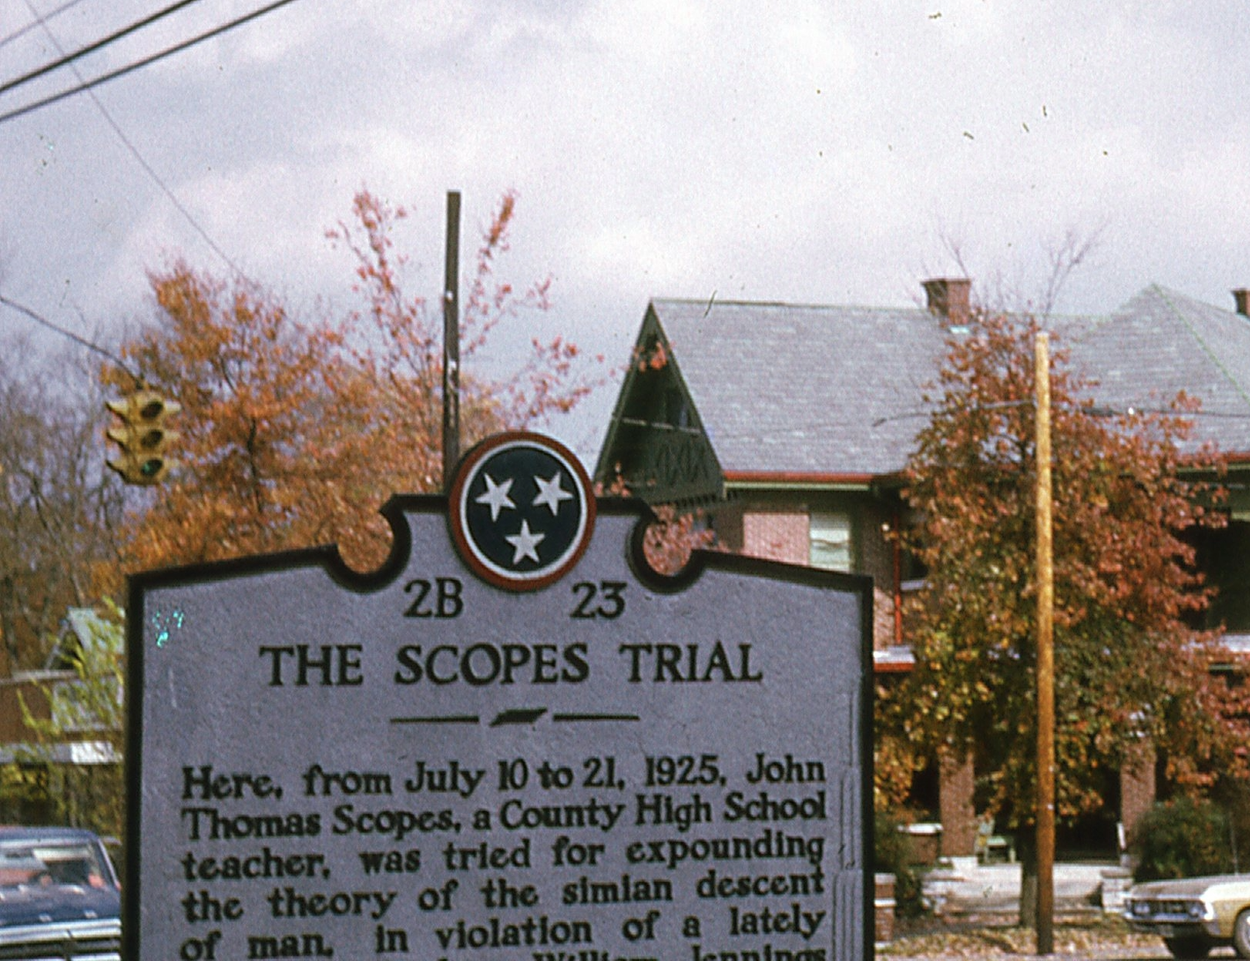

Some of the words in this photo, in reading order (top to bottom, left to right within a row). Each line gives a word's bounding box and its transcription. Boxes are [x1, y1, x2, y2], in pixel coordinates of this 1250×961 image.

[403, 577, 464, 619] 2B
[569, 580, 627, 620] 23
[258, 643, 364, 687] THE
[394, 642, 590, 687] SCOPES
[618, 640, 763, 684] TRIAL
[181, 765, 284, 801] Here,
[302, 763, 393, 796] from
[404, 760, 486, 799] July
[497, 757, 529, 791] 10
[536, 761, 574, 790] to
[582, 756, 625, 791] 21,
[645, 754, 727, 787] 1925,
[745, 752, 827, 783] John
[180, 805, 322, 841] Thomas
[331, 803, 462, 842] Scopes,
[472, 809, 492, 831] a
[499, 796, 627, 833] County
[635, 793, 713, 832] High
[722, 790, 827, 822] School
[180, 847, 332, 883] teacher,
[358, 849, 422, 875] was
[442, 839, 532, 872] tried
[551, 835, 605, 867] for
[625, 828, 826, 870] expounding
[181, 890, 245, 924] the
[266, 885, 398, 922] theory
[417, 879, 460, 912] of
[479, 877, 539, 910] the
[561, 875, 674, 906] simian
[696, 868, 826, 900] descent
[179, 930, 223, 961] of
[374, 924, 410, 955] in
[434, 914, 593, 950] violation
[621, 910, 662, 942] of
[681, 915, 701, 939] a
[728, 903, 827, 942] lately
